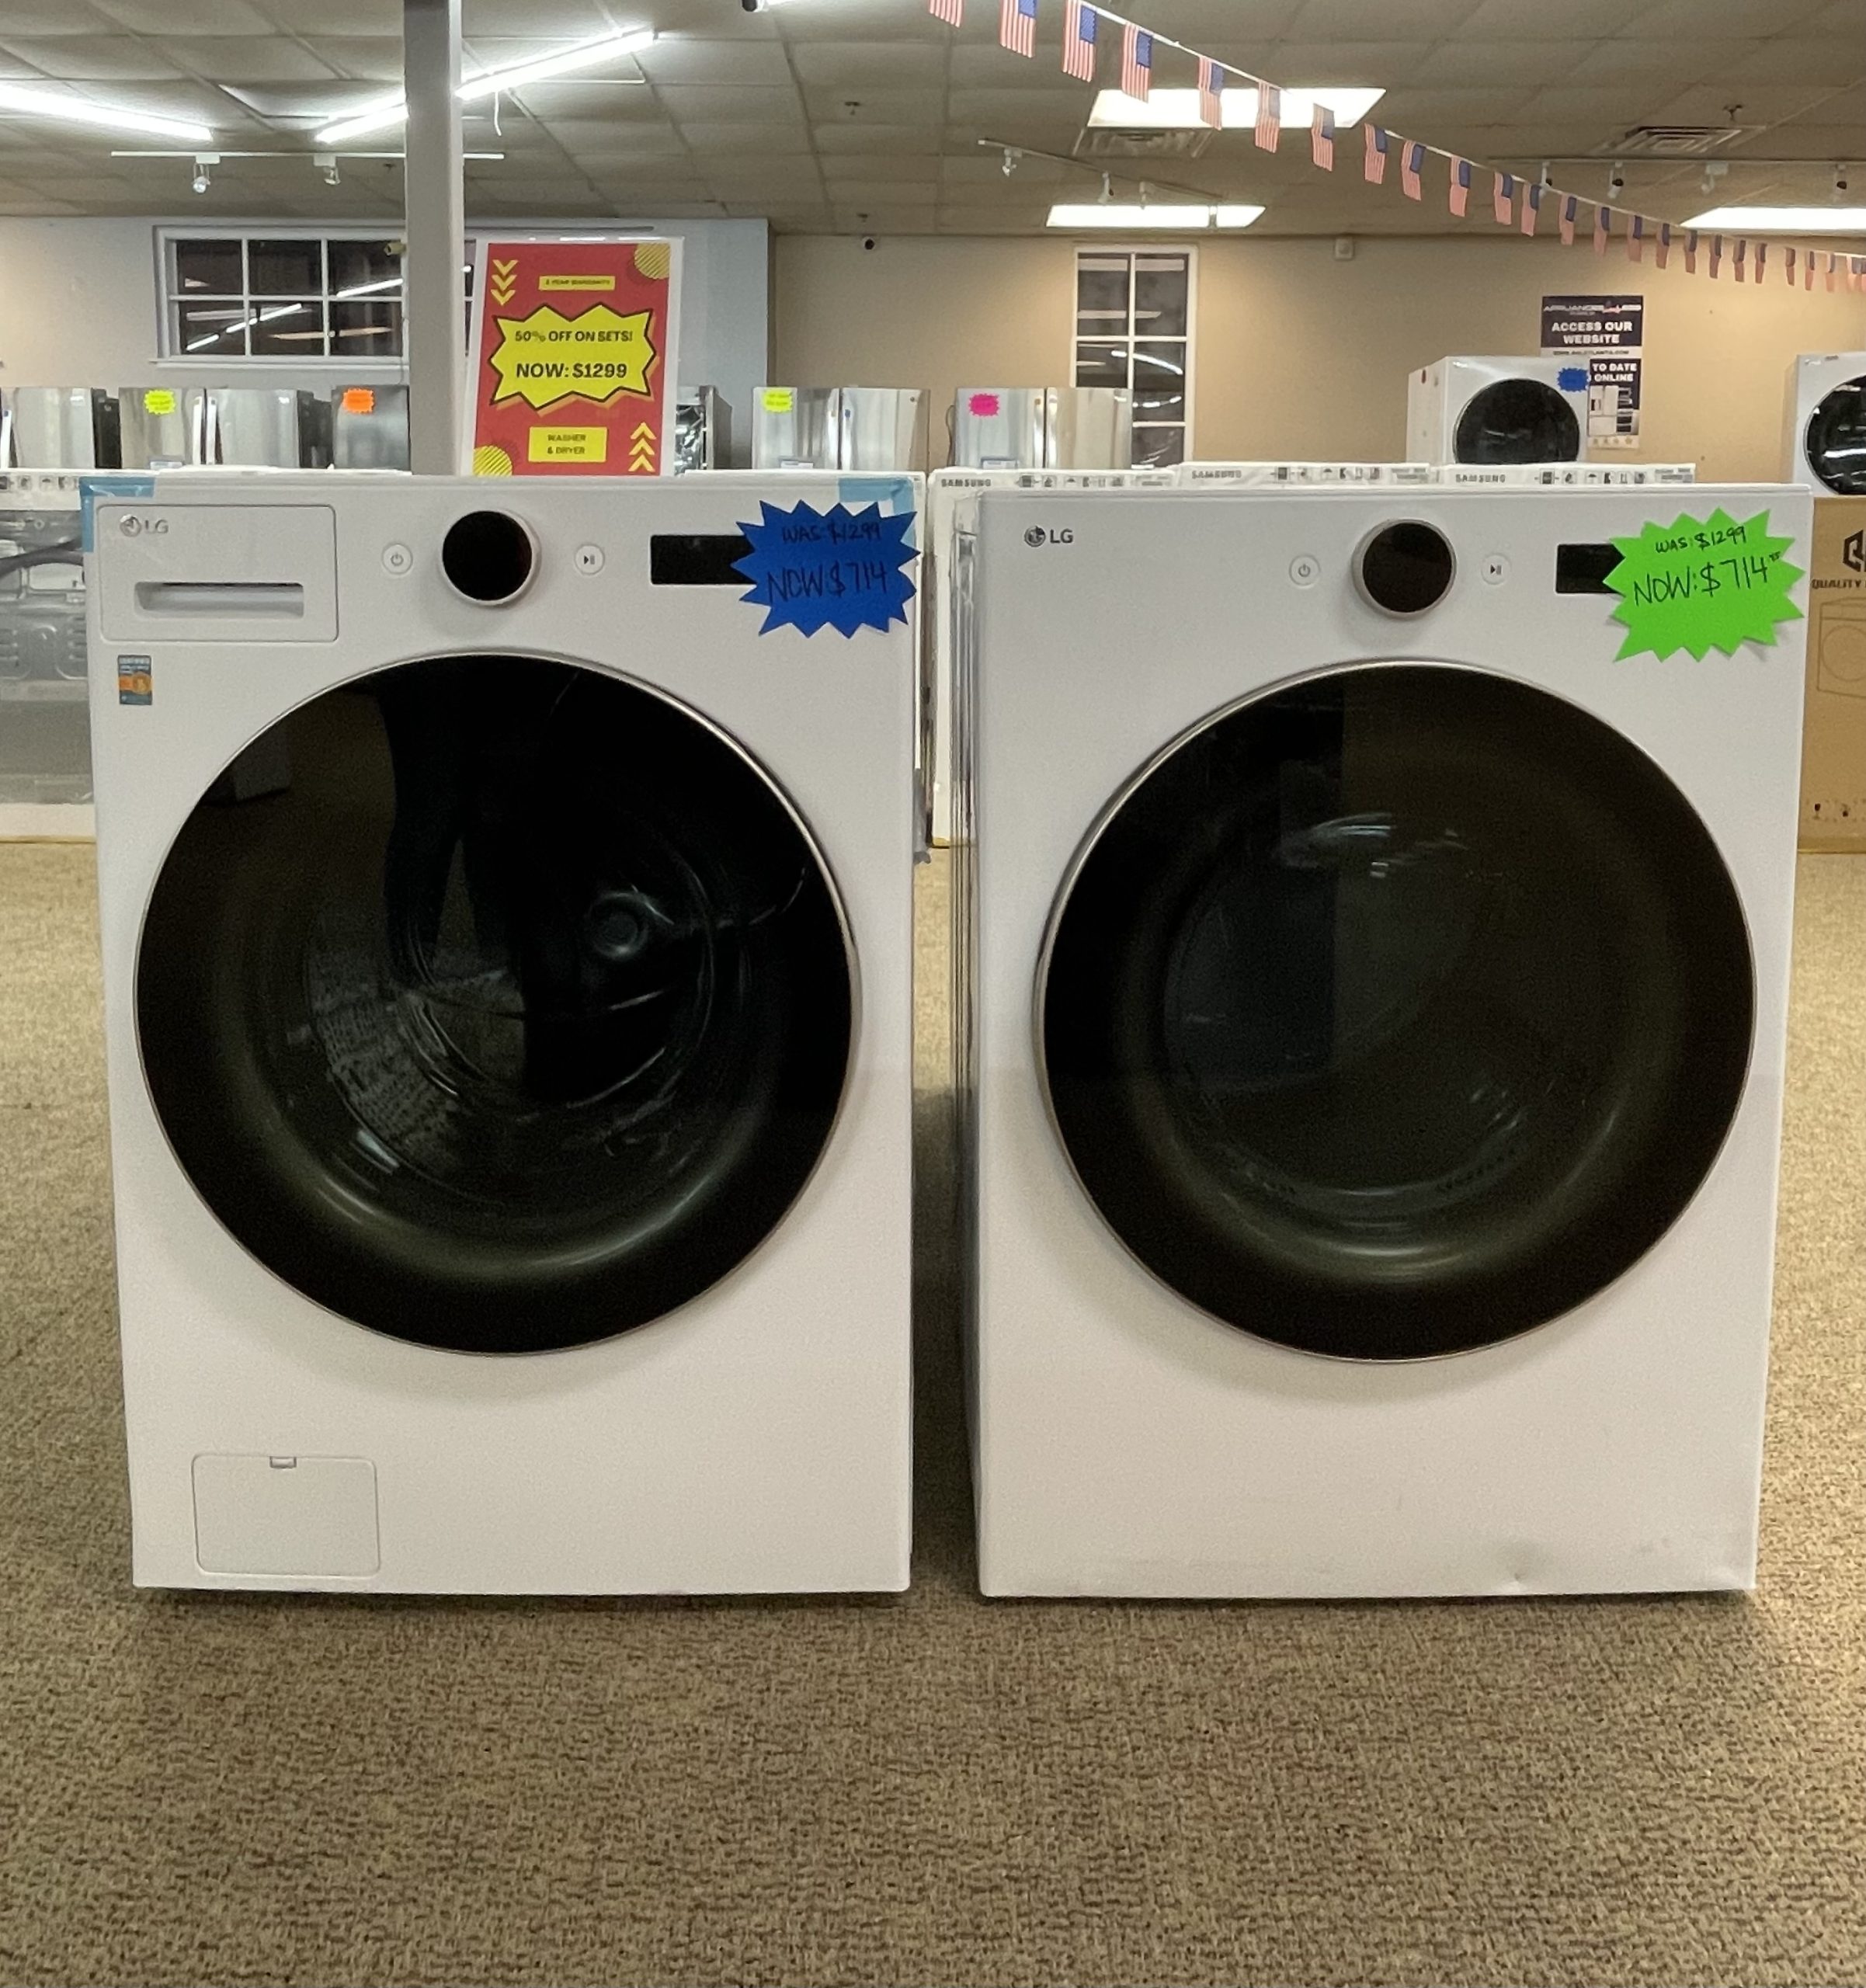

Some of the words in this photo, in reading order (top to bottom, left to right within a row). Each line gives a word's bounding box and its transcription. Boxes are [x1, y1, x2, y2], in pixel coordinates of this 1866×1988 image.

[1552, 321, 1602, 332] ACCESS
[1604, 321, 1633, 332] OUR
[515, 330, 546, 342] 50%
[548, 330, 572, 342] OFF
[575, 330, 595, 342] ON
[597, 330, 633, 342] SETS!
[1563, 334, 1620, 344] WEBSITE
[516, 363, 569, 378] NOW:
[572, 363, 627, 378] $1299
[1592, 363, 1607, 371] TO
[1609, 363, 1637, 371] DATE
[1594, 374, 1634, 382] ONLINE
[555, 446, 586, 454] DRYER
[940, 478, 992, 488] SAMSUNG
[1455, 473, 1506, 483] SAMSUNG
[144, 519, 169, 534] LG
[827, 518, 882, 545] $1299
[1050, 528, 1074, 544] LG
[1694, 525, 1746, 551] $1299
[1633, 565, 1697, 607] NOW:
[1812, 579, 1862, 589] QUALITY
